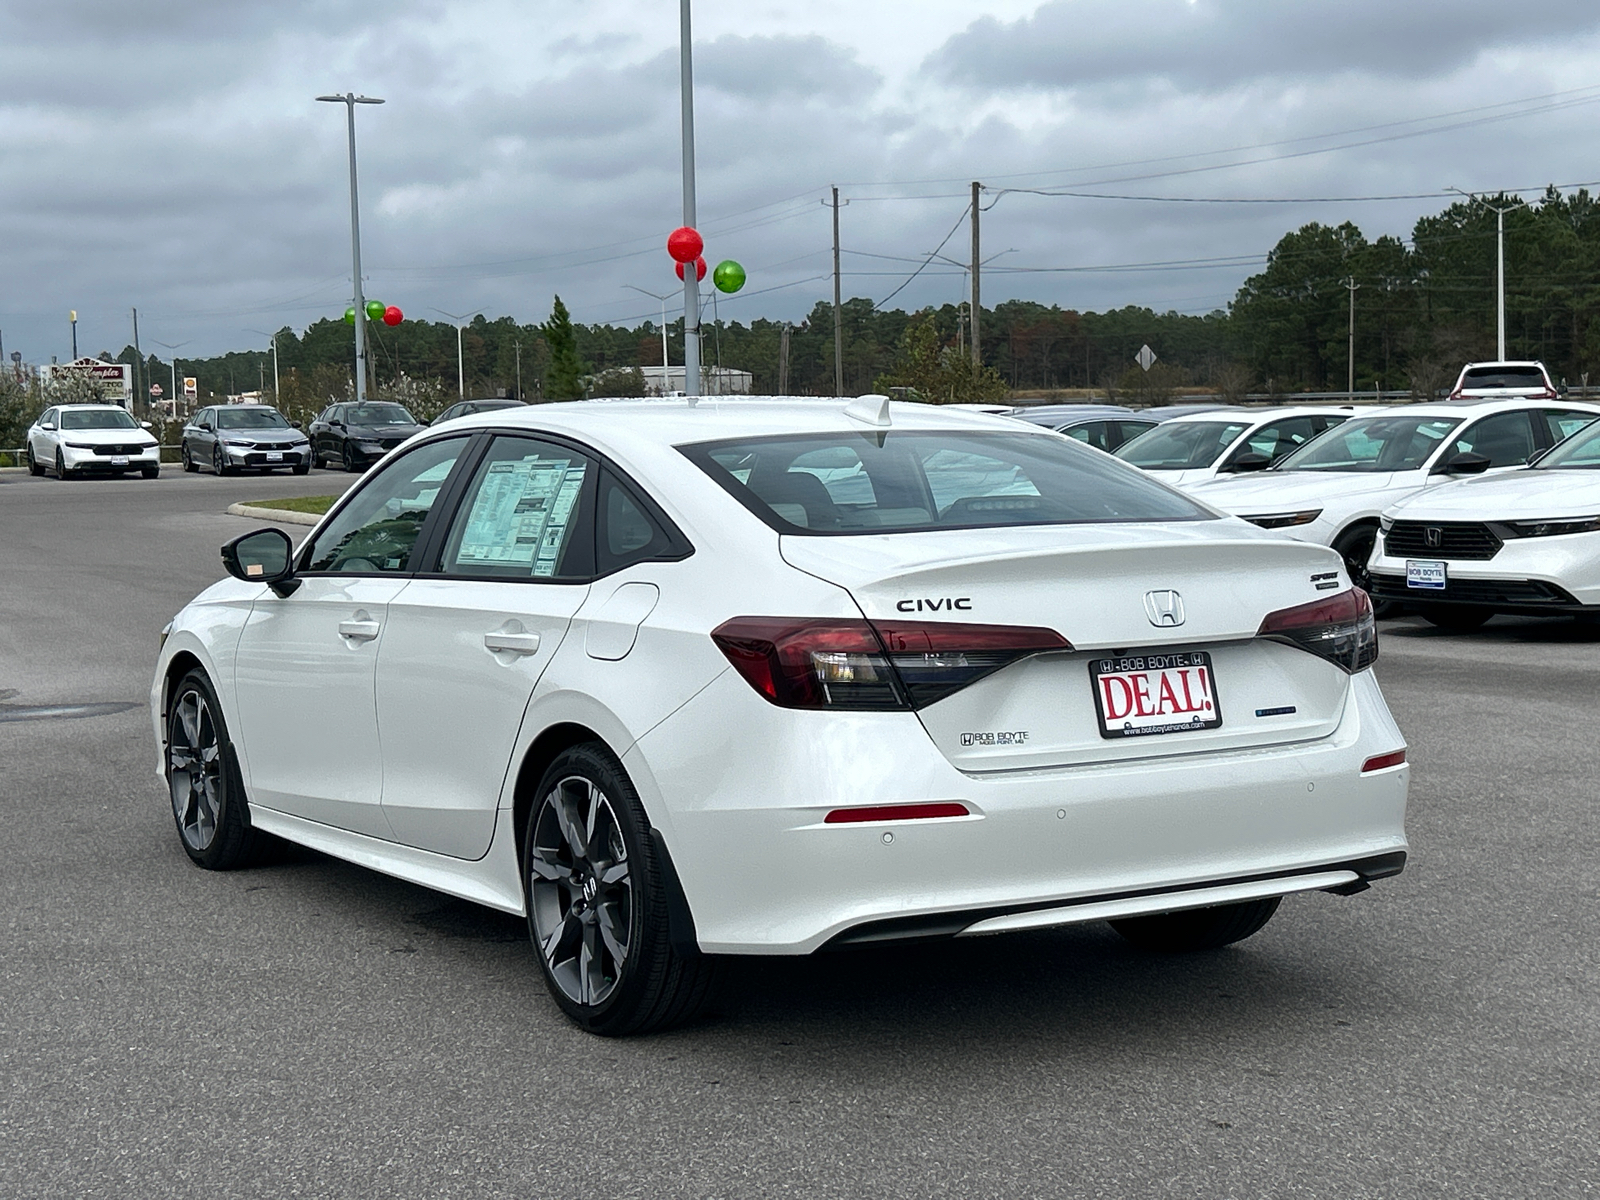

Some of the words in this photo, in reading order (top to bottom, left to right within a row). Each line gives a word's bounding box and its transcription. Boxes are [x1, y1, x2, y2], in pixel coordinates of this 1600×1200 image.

[896, 597, 973, 613] CIVIC
[1100, 667, 1212, 721] DEAL!
[997, 731, 1029, 740] BOYTE
